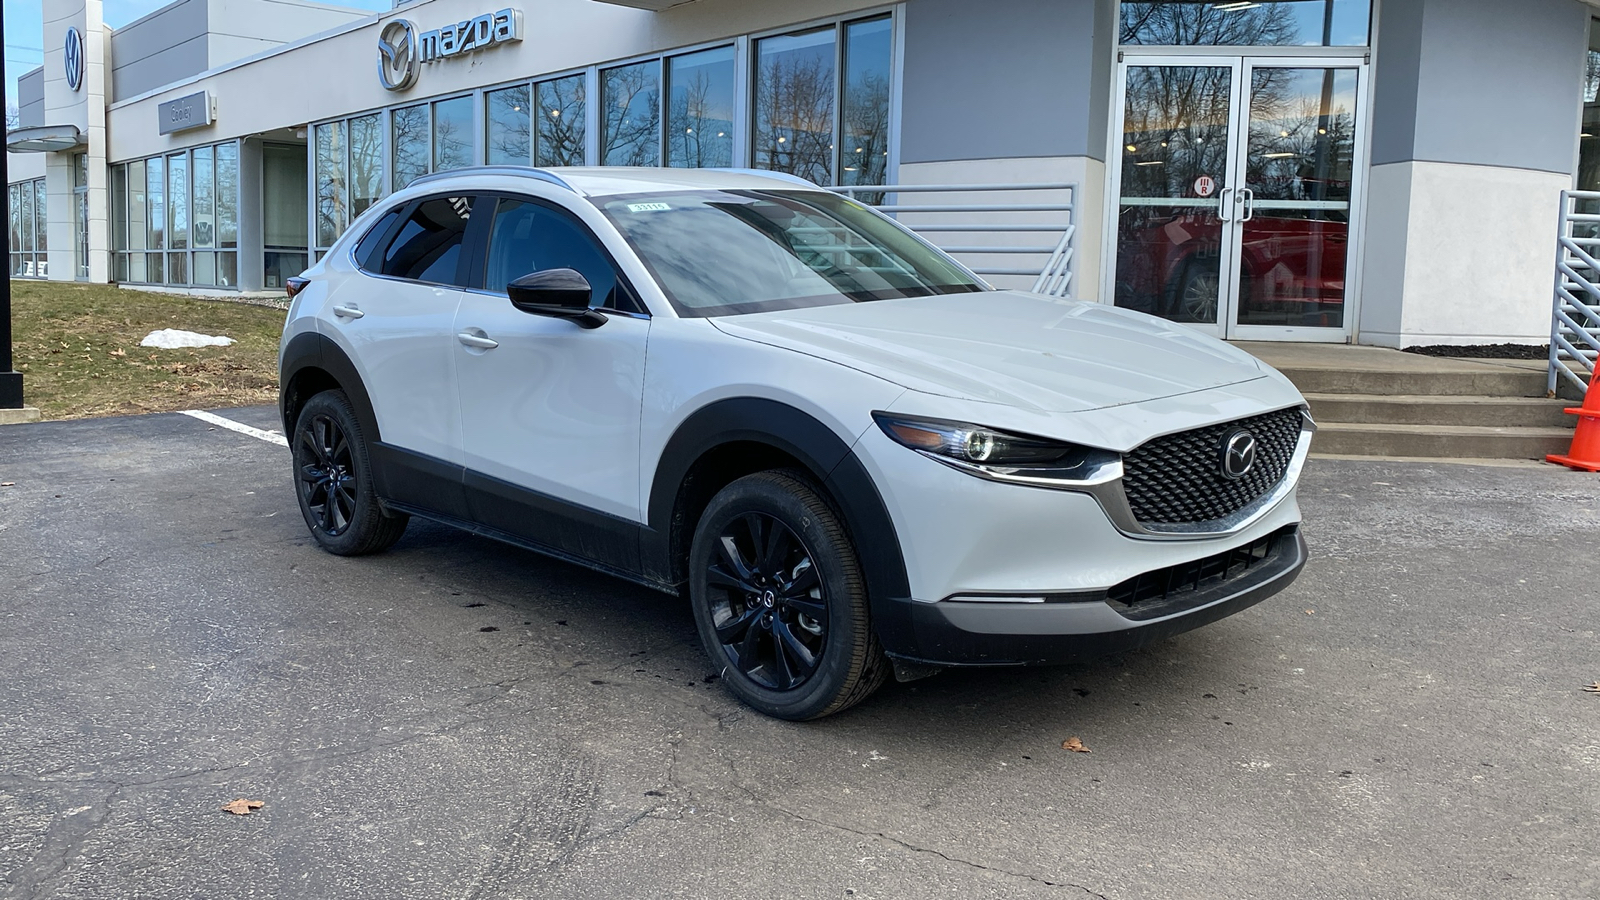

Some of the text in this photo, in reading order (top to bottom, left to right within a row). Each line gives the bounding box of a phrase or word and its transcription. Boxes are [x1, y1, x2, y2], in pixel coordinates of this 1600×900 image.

[419, 8, 518, 63] mazda
[171, 100, 193, 123] Cooley
[1201, 186, 1208, 194] R
